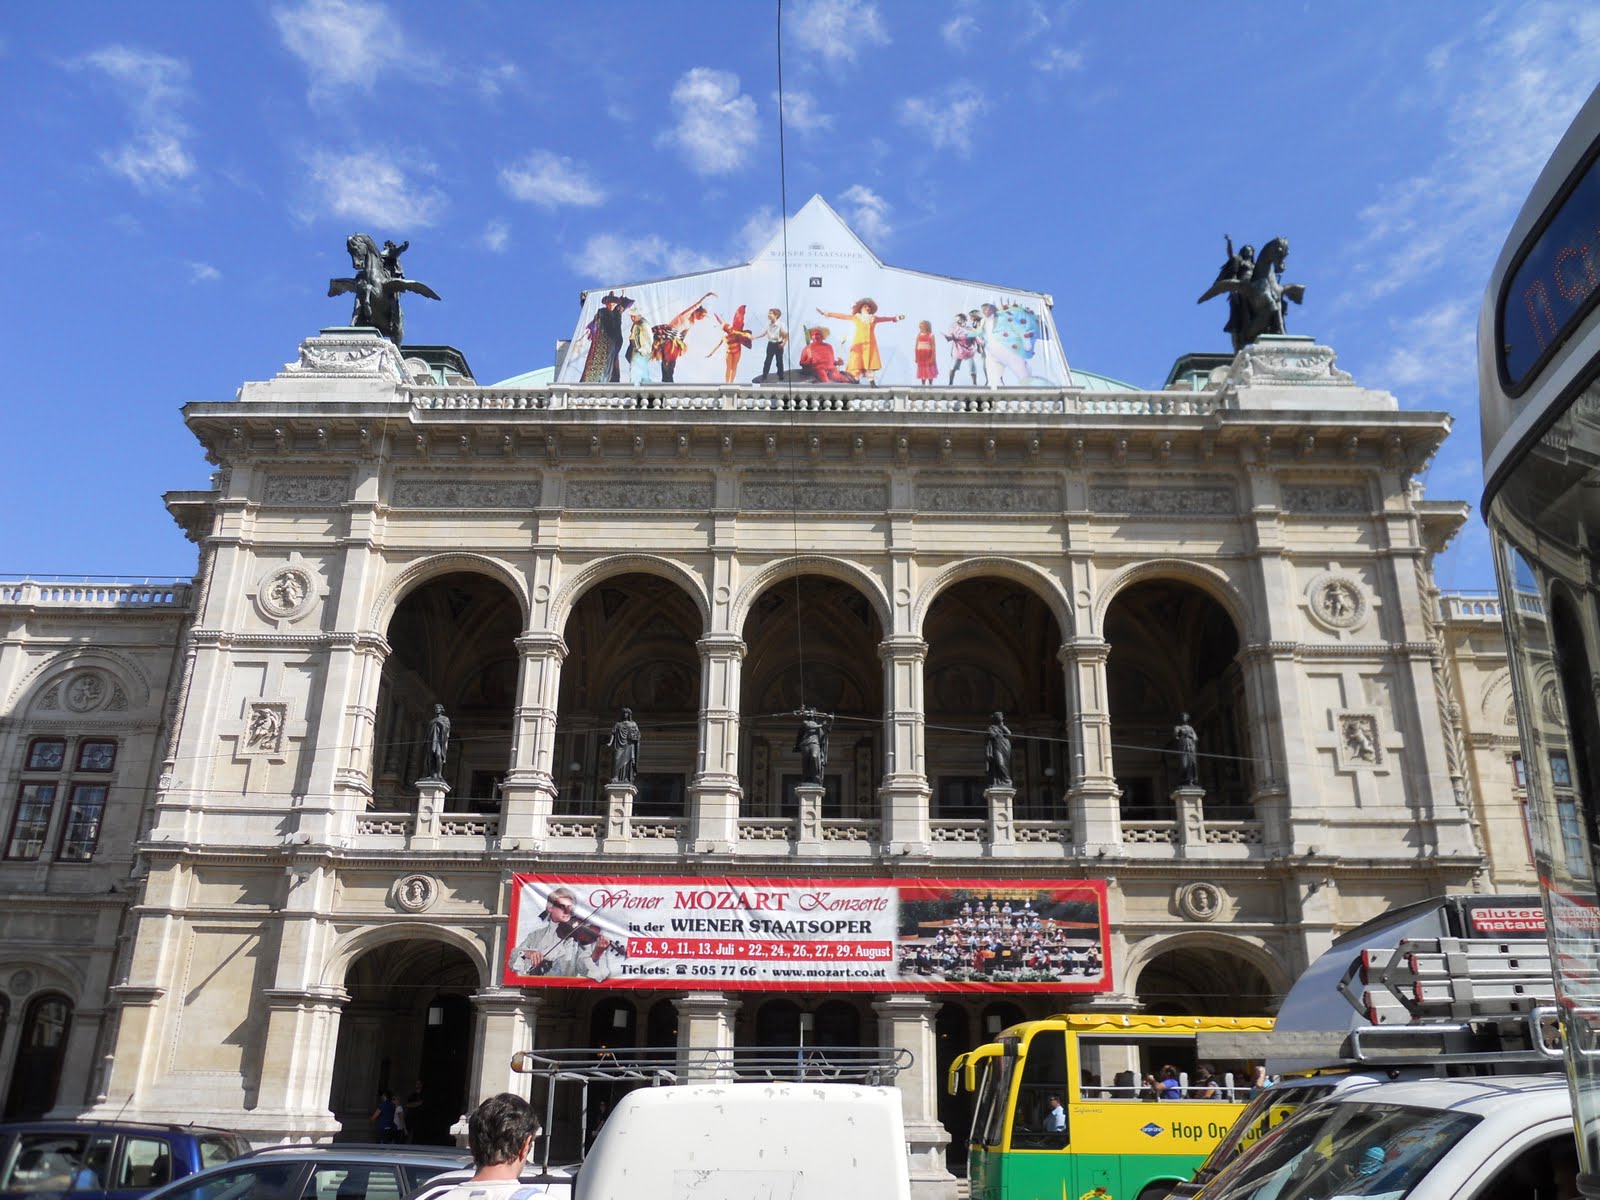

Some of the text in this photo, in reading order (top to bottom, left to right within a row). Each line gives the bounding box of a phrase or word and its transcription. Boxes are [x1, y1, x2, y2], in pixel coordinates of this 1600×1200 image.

[589, 889, 889, 912] Wiener MOZART Konzerte
[628, 918, 873, 934] in der WIENER STAATSOPER
[631, 941, 891, 960] 7., 8., 9., 11., 13. Juli 22., 24., 26., 27., 29. August
[620, 964, 886, 978] Tickets: 505 77 66 www.mozart.co.at
[1172, 1122, 1203, 1142] Hop
[1208, 1122, 1228, 1139] On
